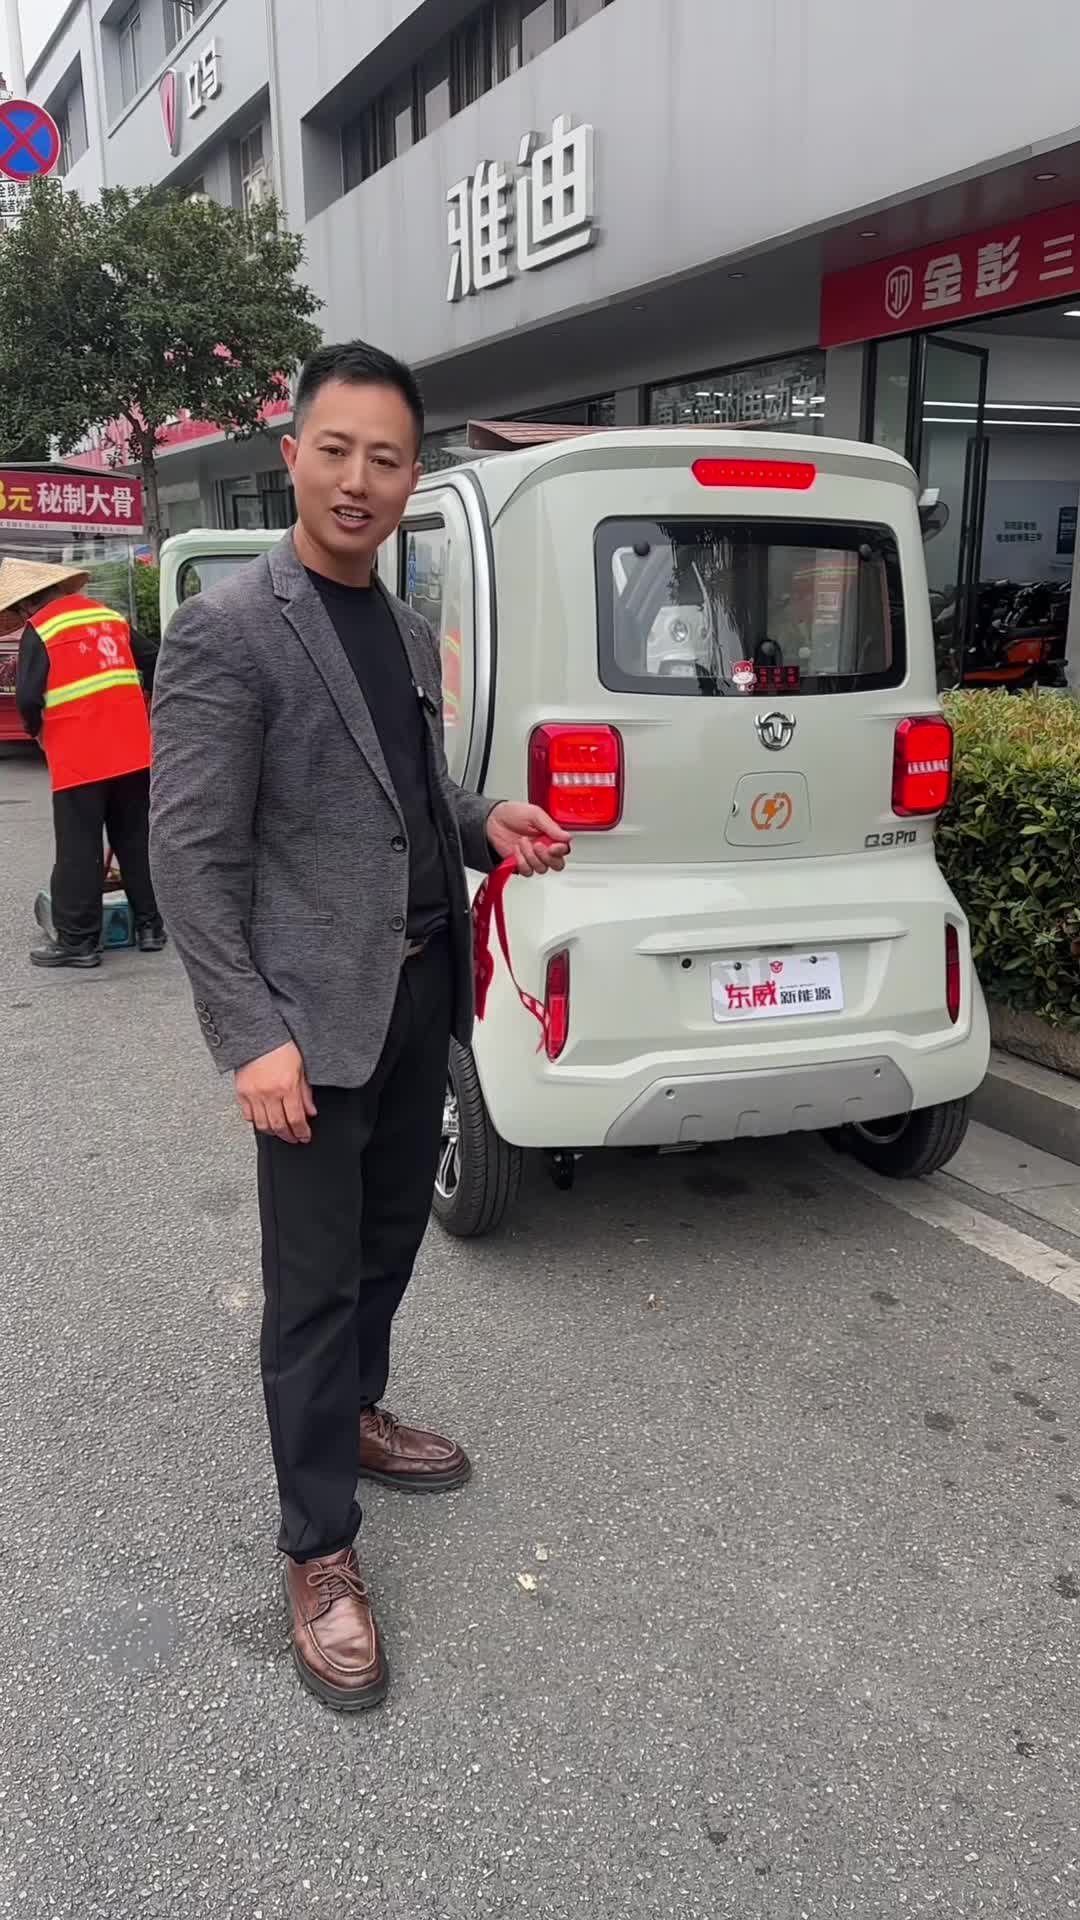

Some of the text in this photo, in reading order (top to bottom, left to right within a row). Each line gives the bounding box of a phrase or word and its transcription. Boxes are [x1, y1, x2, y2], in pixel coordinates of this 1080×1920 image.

[446, 113, 598, 303] 雅迪
[36, 482, 135, 519] 秘制大骨
